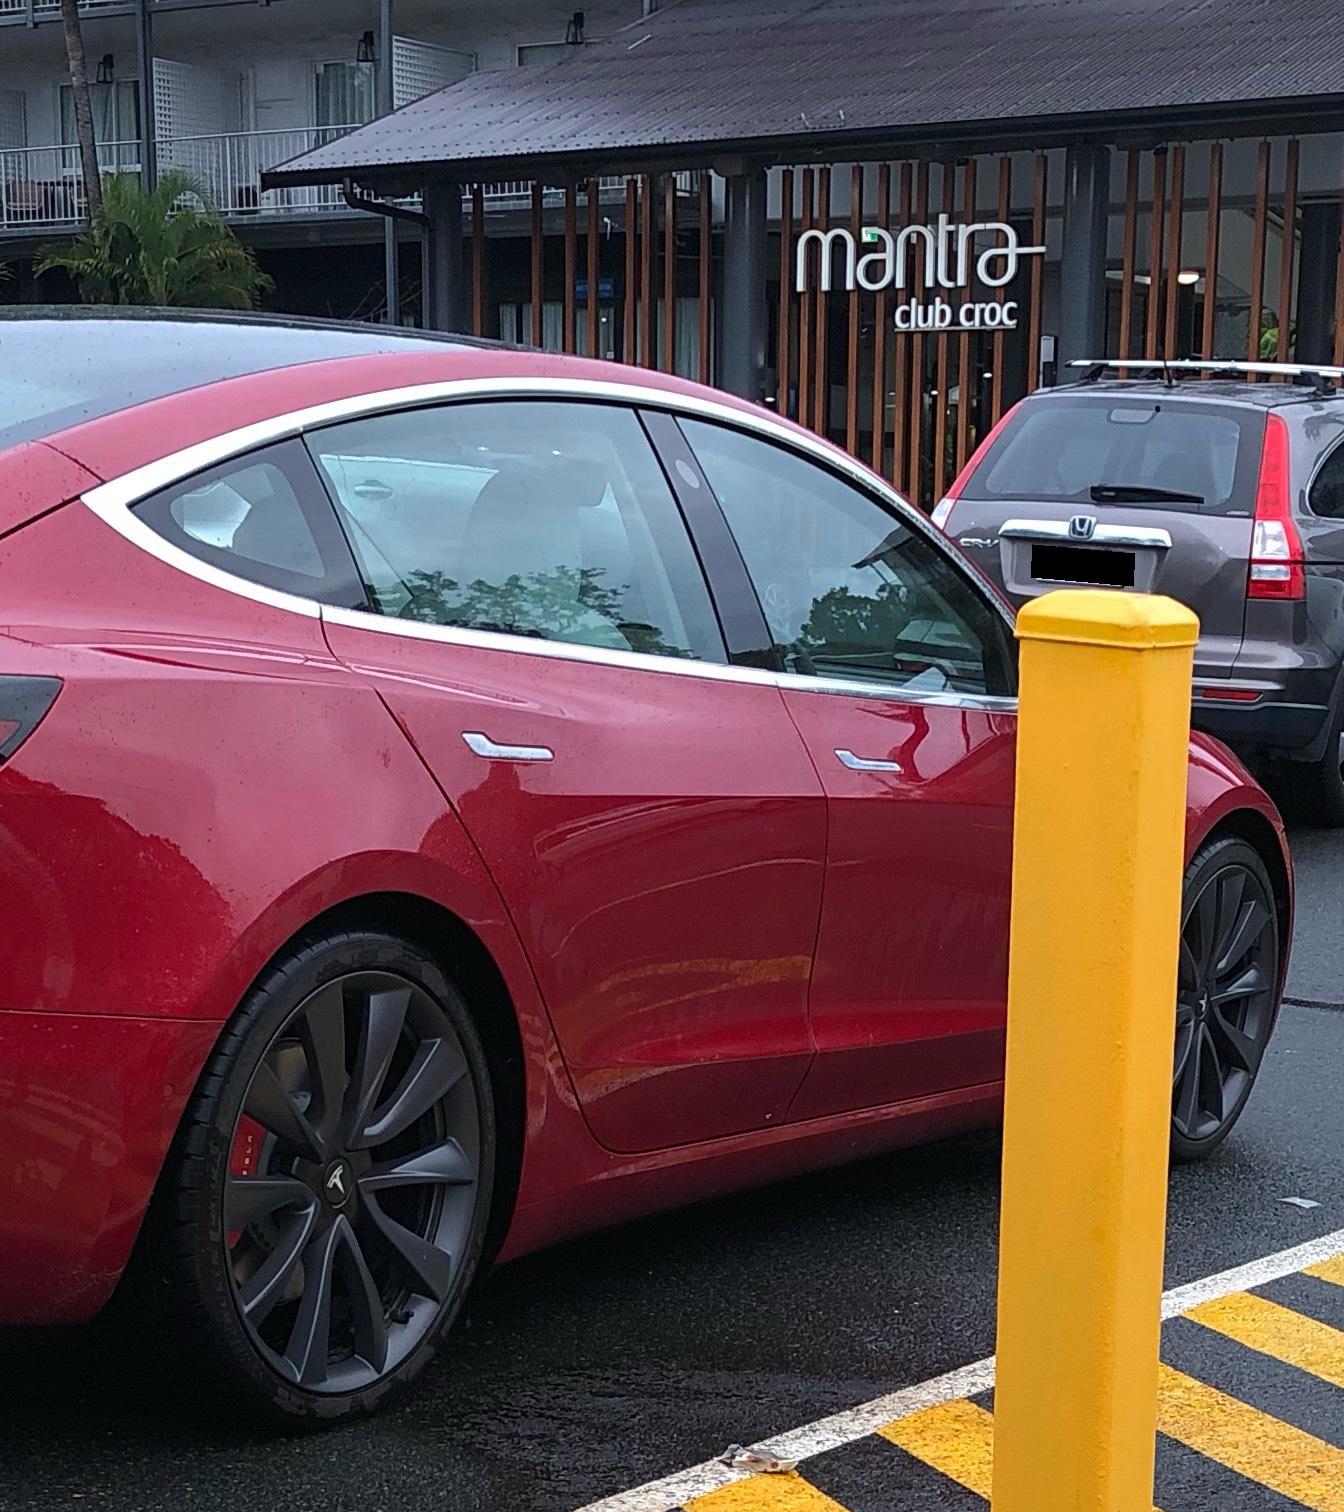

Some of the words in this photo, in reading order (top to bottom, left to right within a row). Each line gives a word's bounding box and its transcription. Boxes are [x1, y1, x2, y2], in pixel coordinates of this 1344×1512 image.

[796, 213, 1046, 292] mantra
[895, 297, 952, 328] club
[959, 302, 1018, 327] croc
